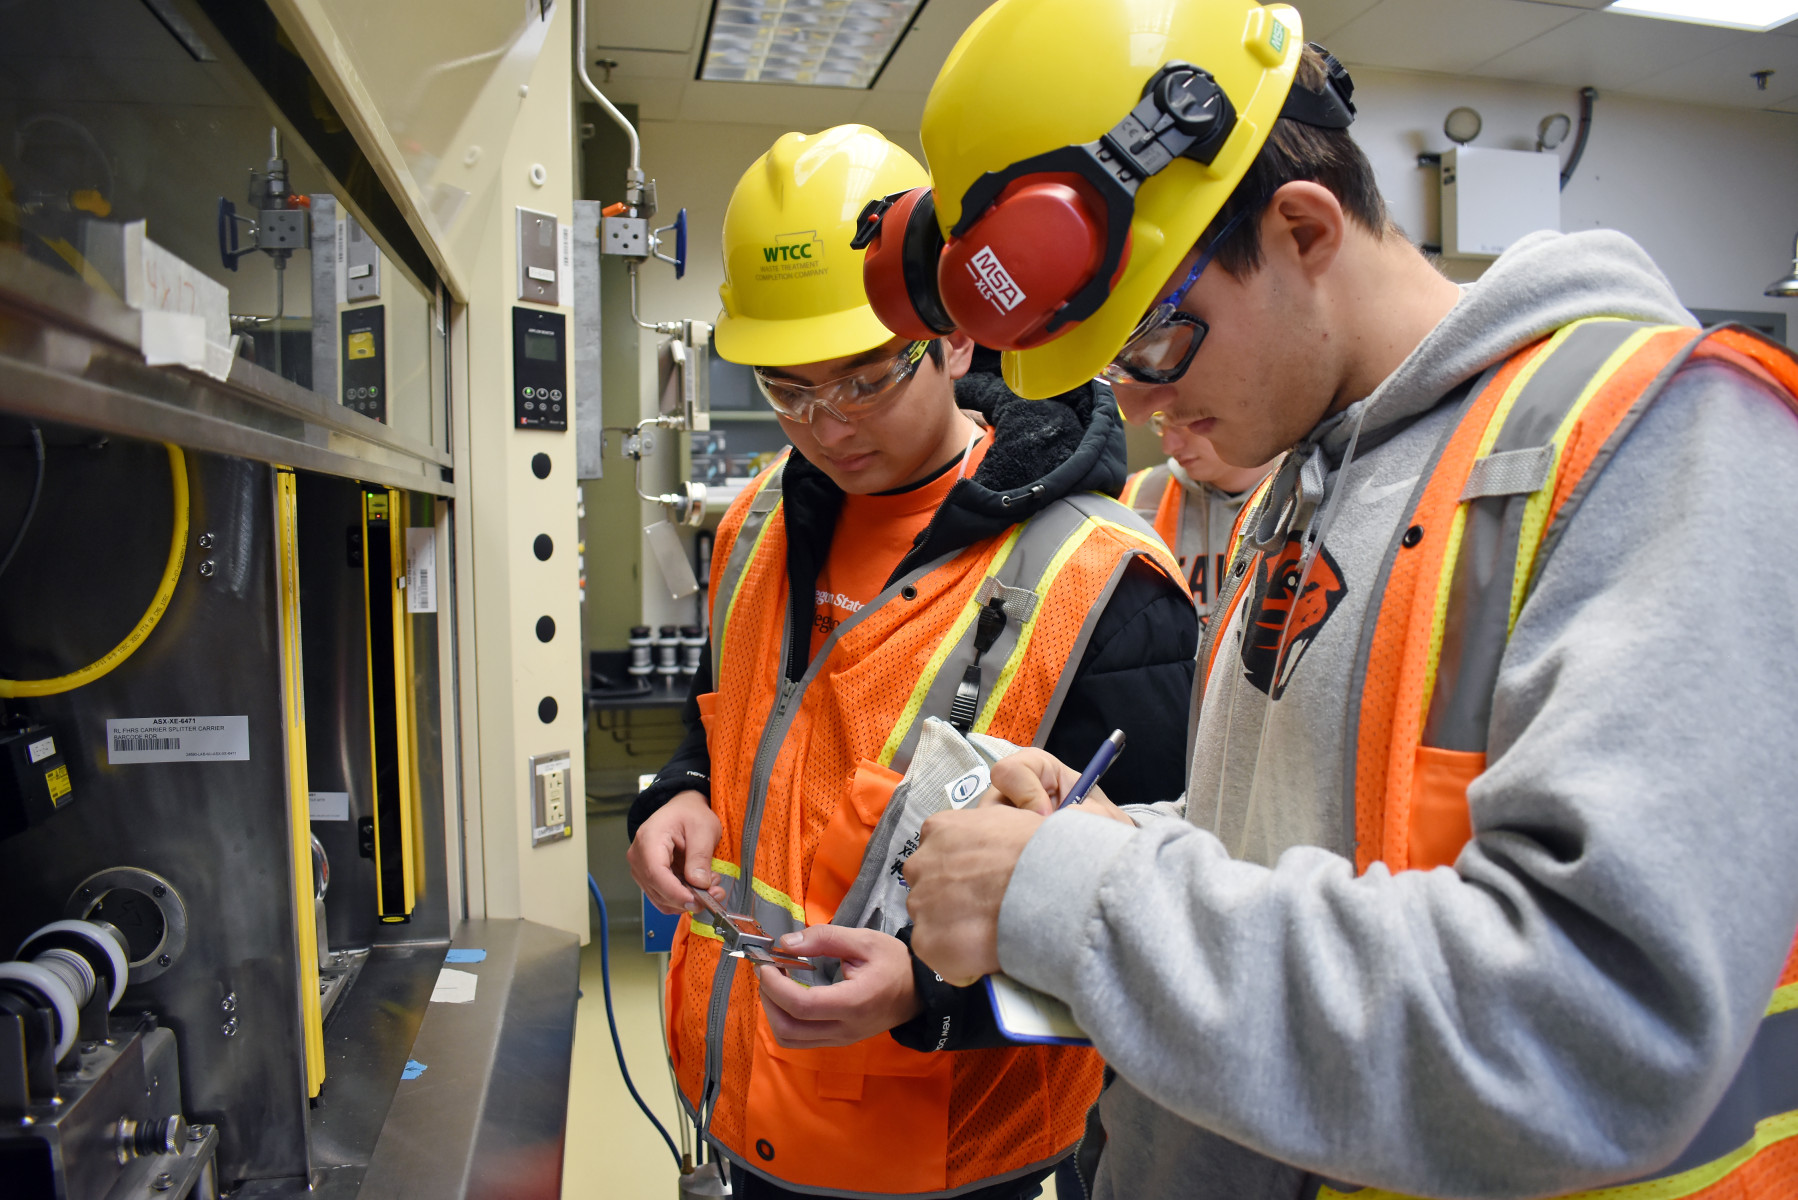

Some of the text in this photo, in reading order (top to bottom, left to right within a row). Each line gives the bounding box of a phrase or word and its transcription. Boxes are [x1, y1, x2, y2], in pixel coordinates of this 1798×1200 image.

[1271, 20, 1284, 51] MSA
[763, 243, 812, 263] WTCC
[755, 267, 829, 281] COMPLETION COMPANY
[760, 260, 819, 273] WASTE TREATMENT
[974, 278, 994, 300] XLS
[976, 251, 1019, 306] MSA
[686, 770, 706, 779] new
[941, 1015, 951, 1037] new
